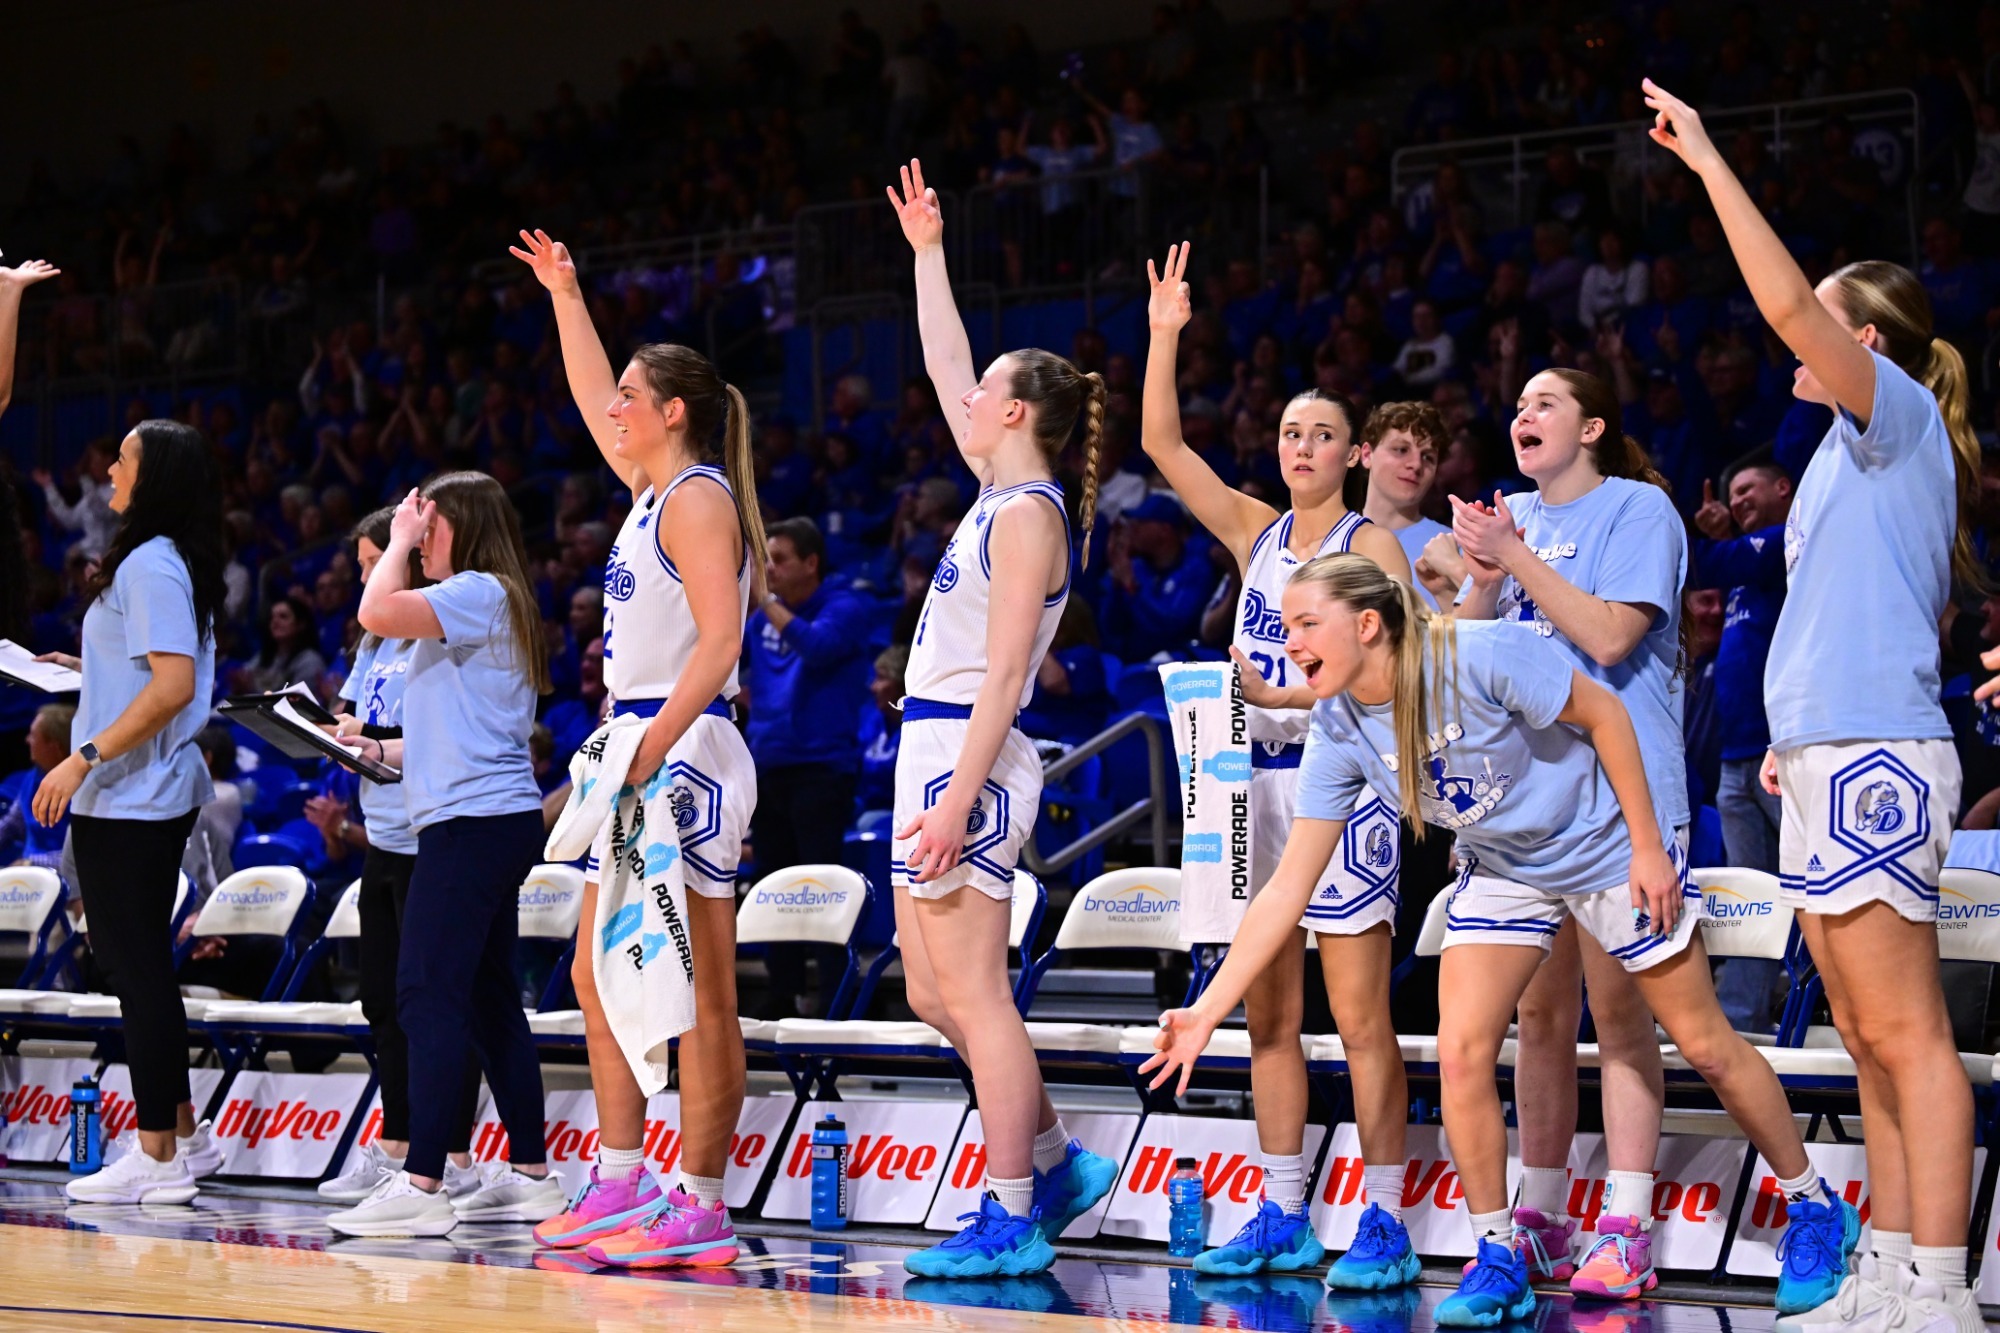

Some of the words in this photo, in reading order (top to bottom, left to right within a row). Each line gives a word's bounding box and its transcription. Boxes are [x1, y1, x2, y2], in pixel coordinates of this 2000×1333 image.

[1241, 588, 1288, 645] Dra
[756, 886, 848, 905] broadlawns
[1107, 915, 1132, 923] MEDICAL
[1134, 914, 1161, 923] CENTER
[1936, 921, 1968, 930] CENTER
[77, 1104, 86, 1163] POWERADE
[216, 1099, 341, 1149] HyVee
[839, 1146, 847, 1214] POWERADE
